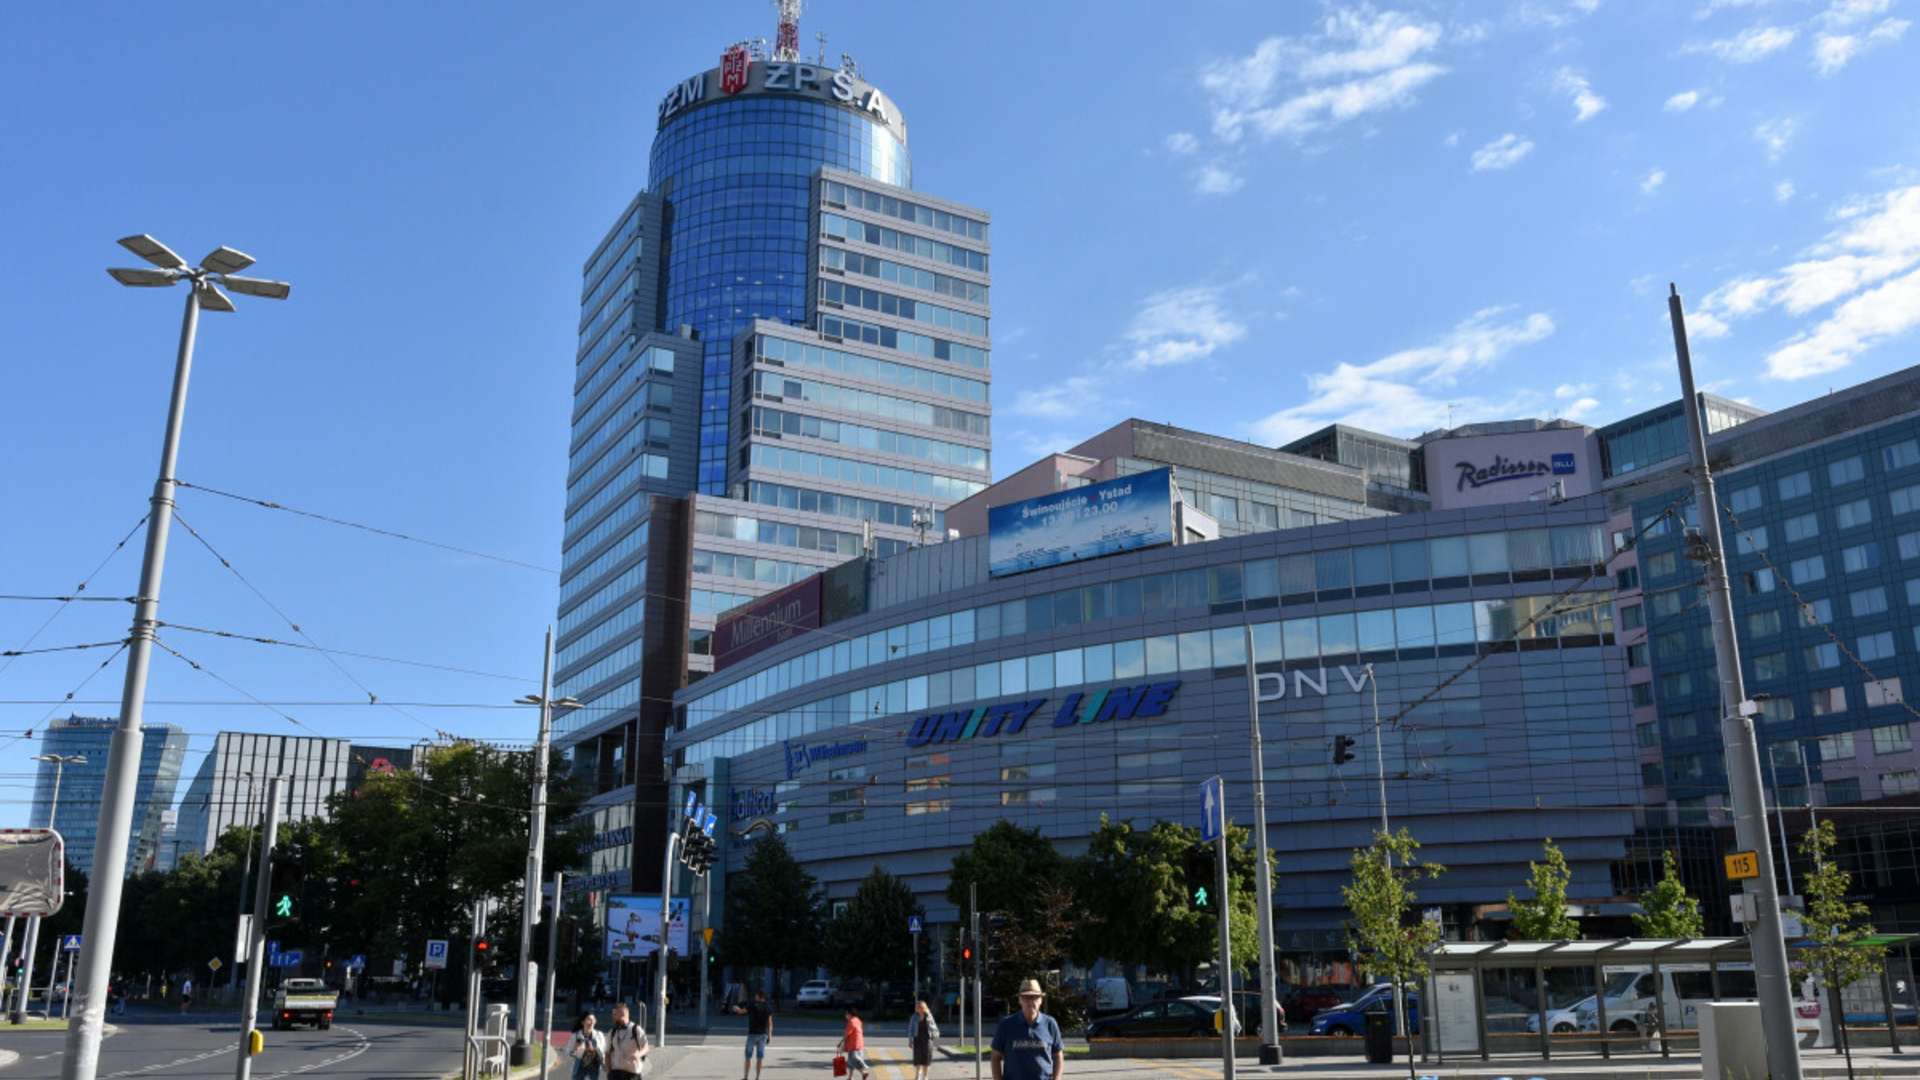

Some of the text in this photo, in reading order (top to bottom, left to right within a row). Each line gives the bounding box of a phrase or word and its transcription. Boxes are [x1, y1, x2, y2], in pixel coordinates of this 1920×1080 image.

[1455, 454, 1551, 492] Radisson
[1083, 501, 1118, 518] 23.00
[1098, 484, 1132, 501] Ystad
[730, 598, 802, 648] Millennium
[1255, 662, 1374, 702] DNV
[906, 680, 1182, 748] UNITY LINE
[1732, 857, 1751, 874] 115
